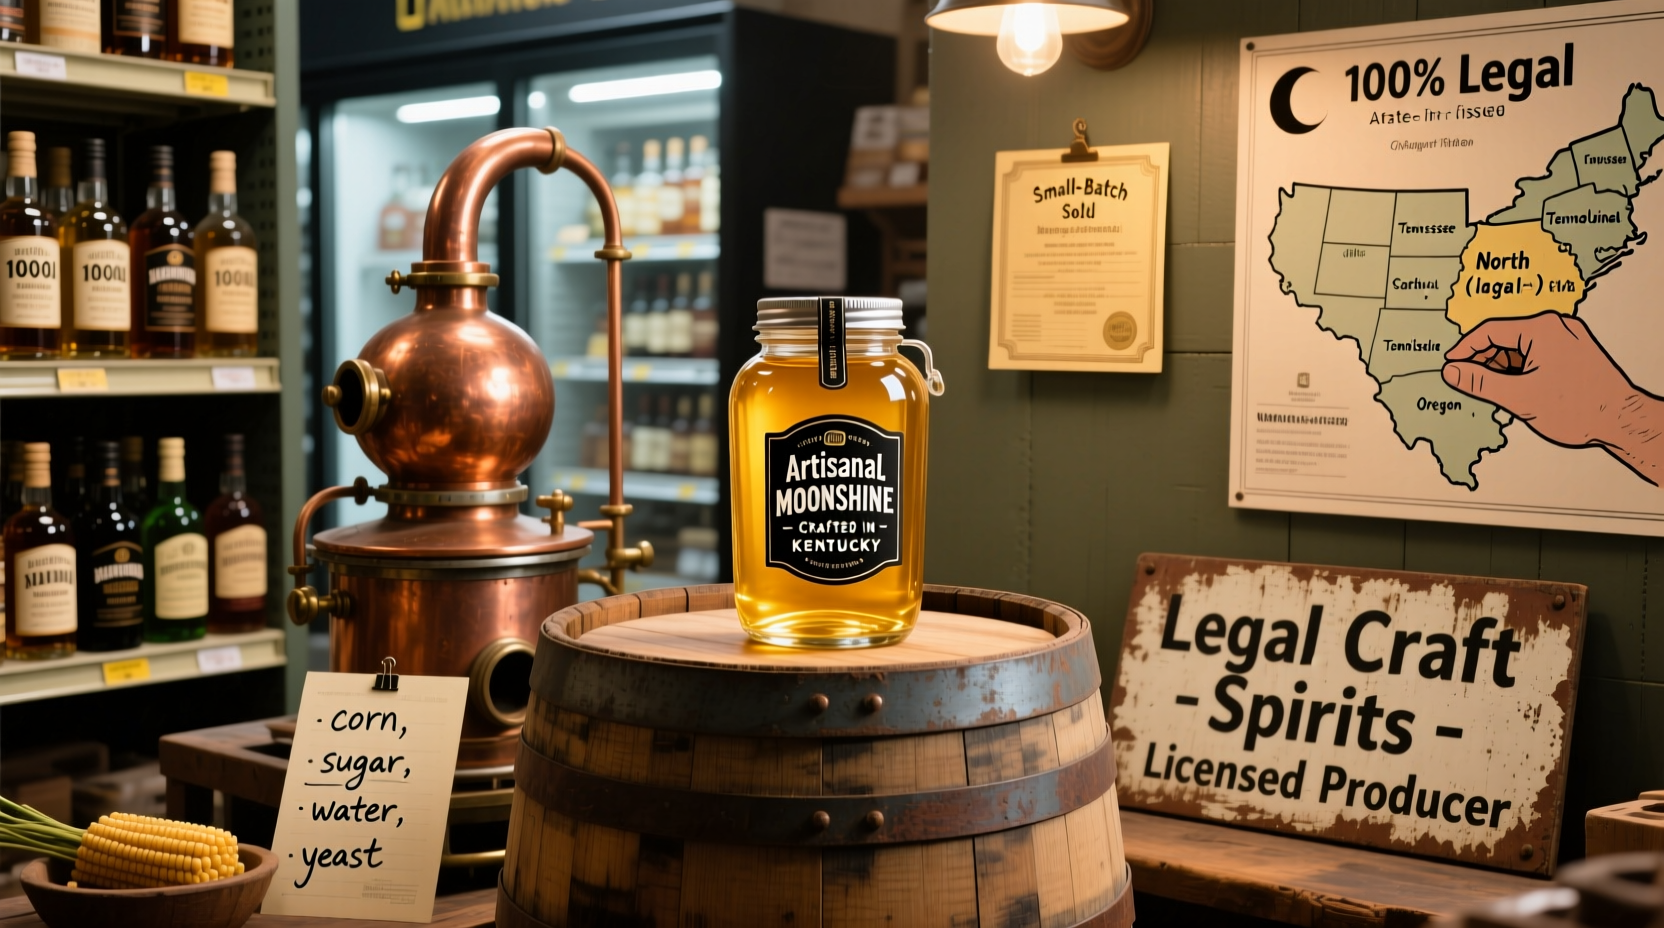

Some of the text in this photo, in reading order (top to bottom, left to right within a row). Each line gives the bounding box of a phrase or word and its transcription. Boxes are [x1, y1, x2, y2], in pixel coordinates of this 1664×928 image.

[1344, 42, 1575, 102] 100% Legal
[1033, 177, 1128, 204] Small-Batch
[1475, 250, 1530, 270] North
[1416, 396, 1462, 416] Oregon
[785, 450, 886, 483] Artisanal
[775, 483, 895, 517] MOONSHINE
[798, 519, 876, 534] CRAFTED IN
[792, 537, 881, 553] KENTUCKY
[1160, 593, 1522, 688] Legal Craft
[330, 709, 407, 740] corn,
[319, 751, 411, 791] sugar,
[1143, 741, 1512, 829] Licensed Producer
[311, 795, 404, 828] water,
[293, 837, 384, 889] yeast
